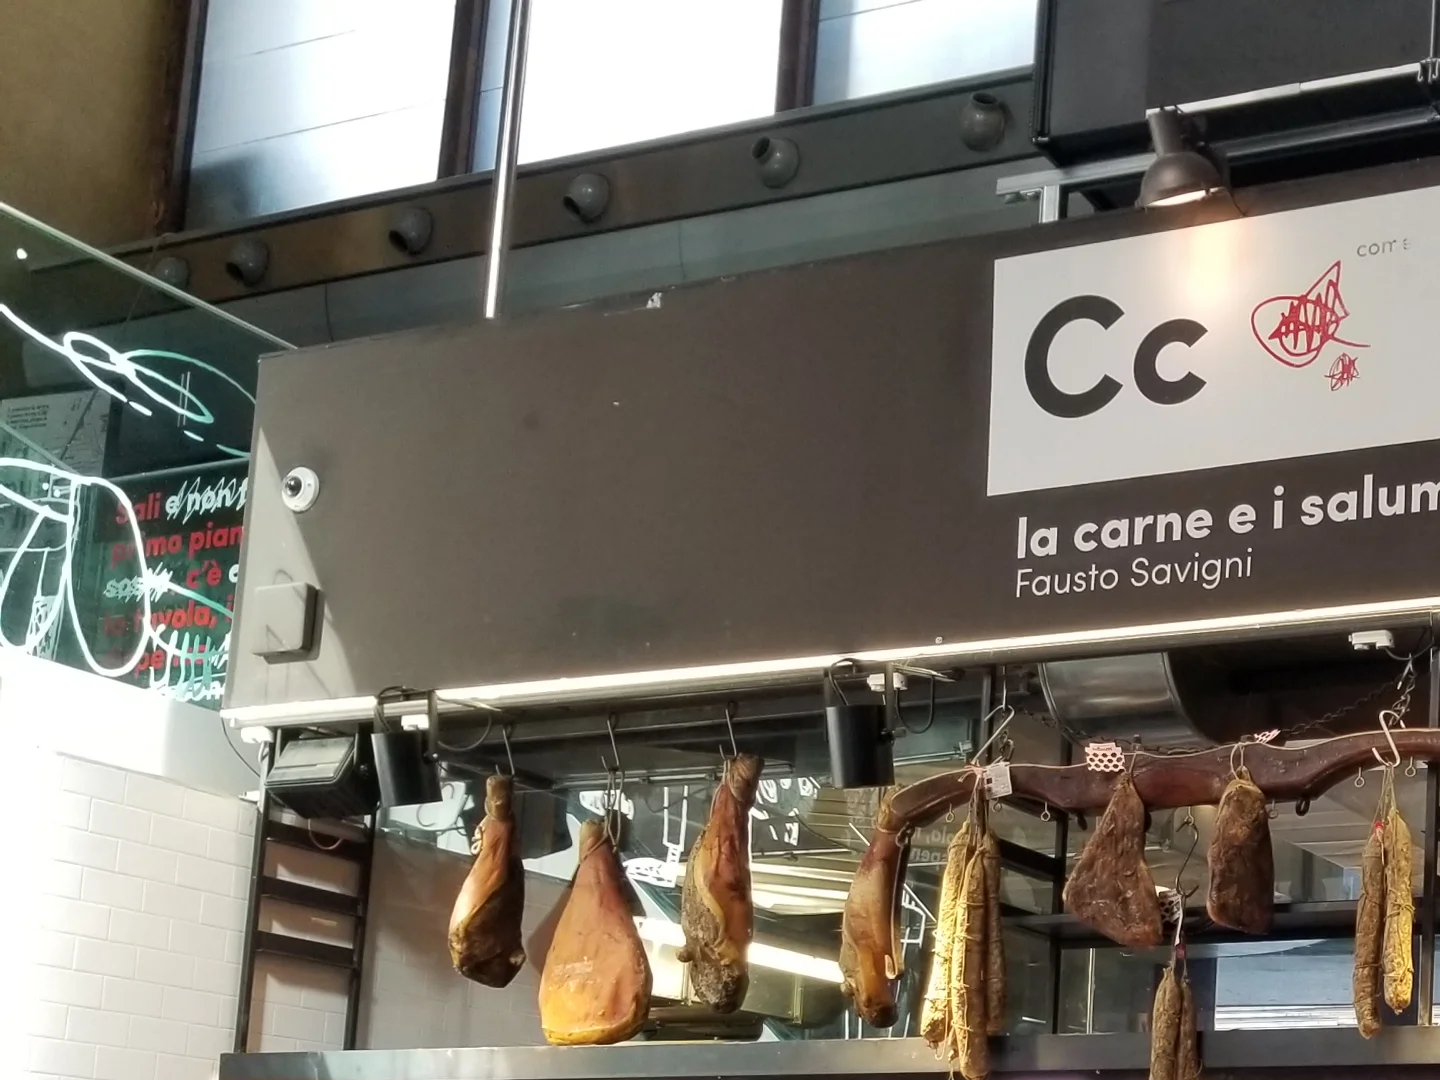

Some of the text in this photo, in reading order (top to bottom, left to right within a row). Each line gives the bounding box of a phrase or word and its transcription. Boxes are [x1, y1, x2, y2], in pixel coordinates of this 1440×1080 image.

[1024, 294, 1208, 418] Cc
[1017, 517, 1058, 559] la
[1073, 503, 1213, 552] carne
[1228, 503, 1257, 535] e
[1273, 485, 1285, 530] i
[1016, 548, 1253, 598] Fausto Savigni
